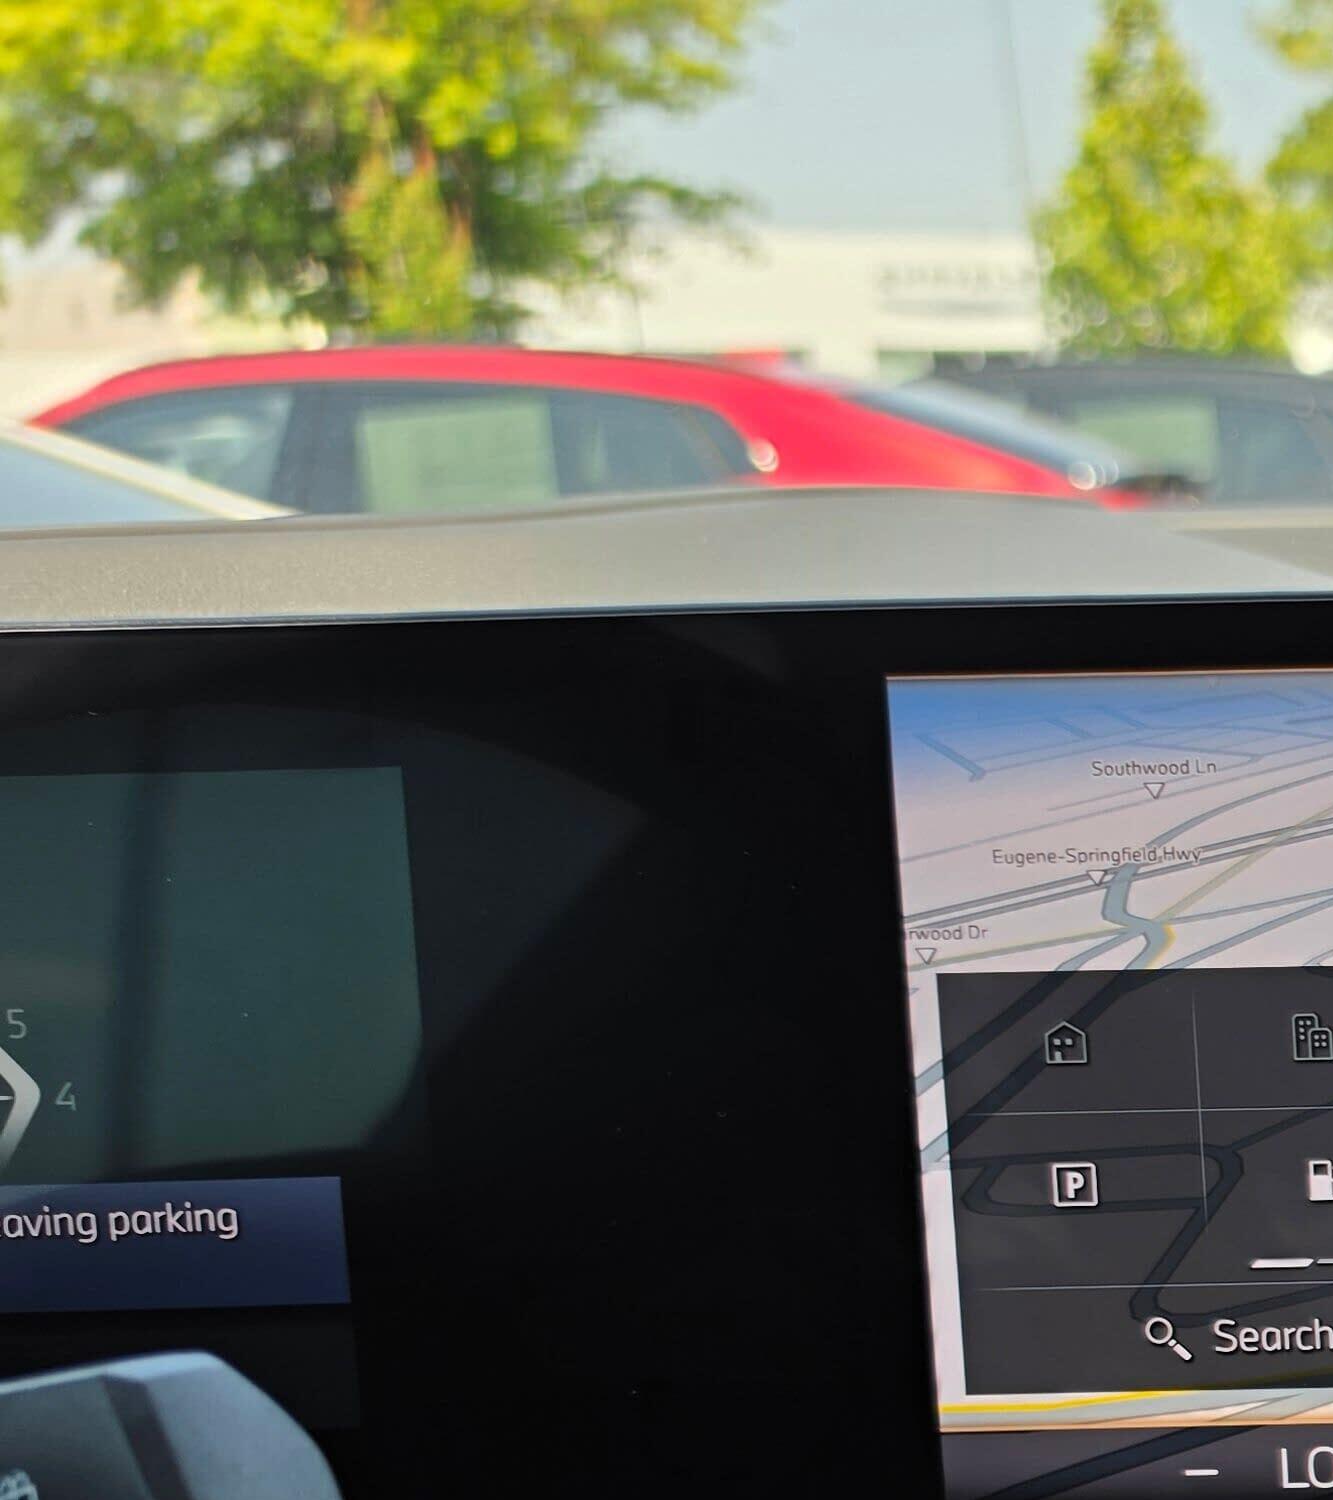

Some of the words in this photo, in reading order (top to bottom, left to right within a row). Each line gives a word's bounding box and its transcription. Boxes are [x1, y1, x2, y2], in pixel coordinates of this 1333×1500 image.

[1091, 758, 1191, 778] Southwood
[1195, 758, 1217, 776] Ln
[991, 846, 1159, 868] Eugene-Springfield
[1161, 846, 1202, 866] Hwy
[967, 924, 989, 940] Dr
[6, 1009, 27, 1039] 5
[54, 1083, 77, 1111] 4
[0, 1205, 99, 1245] aving
[107, 1200, 240, 1243] parking
